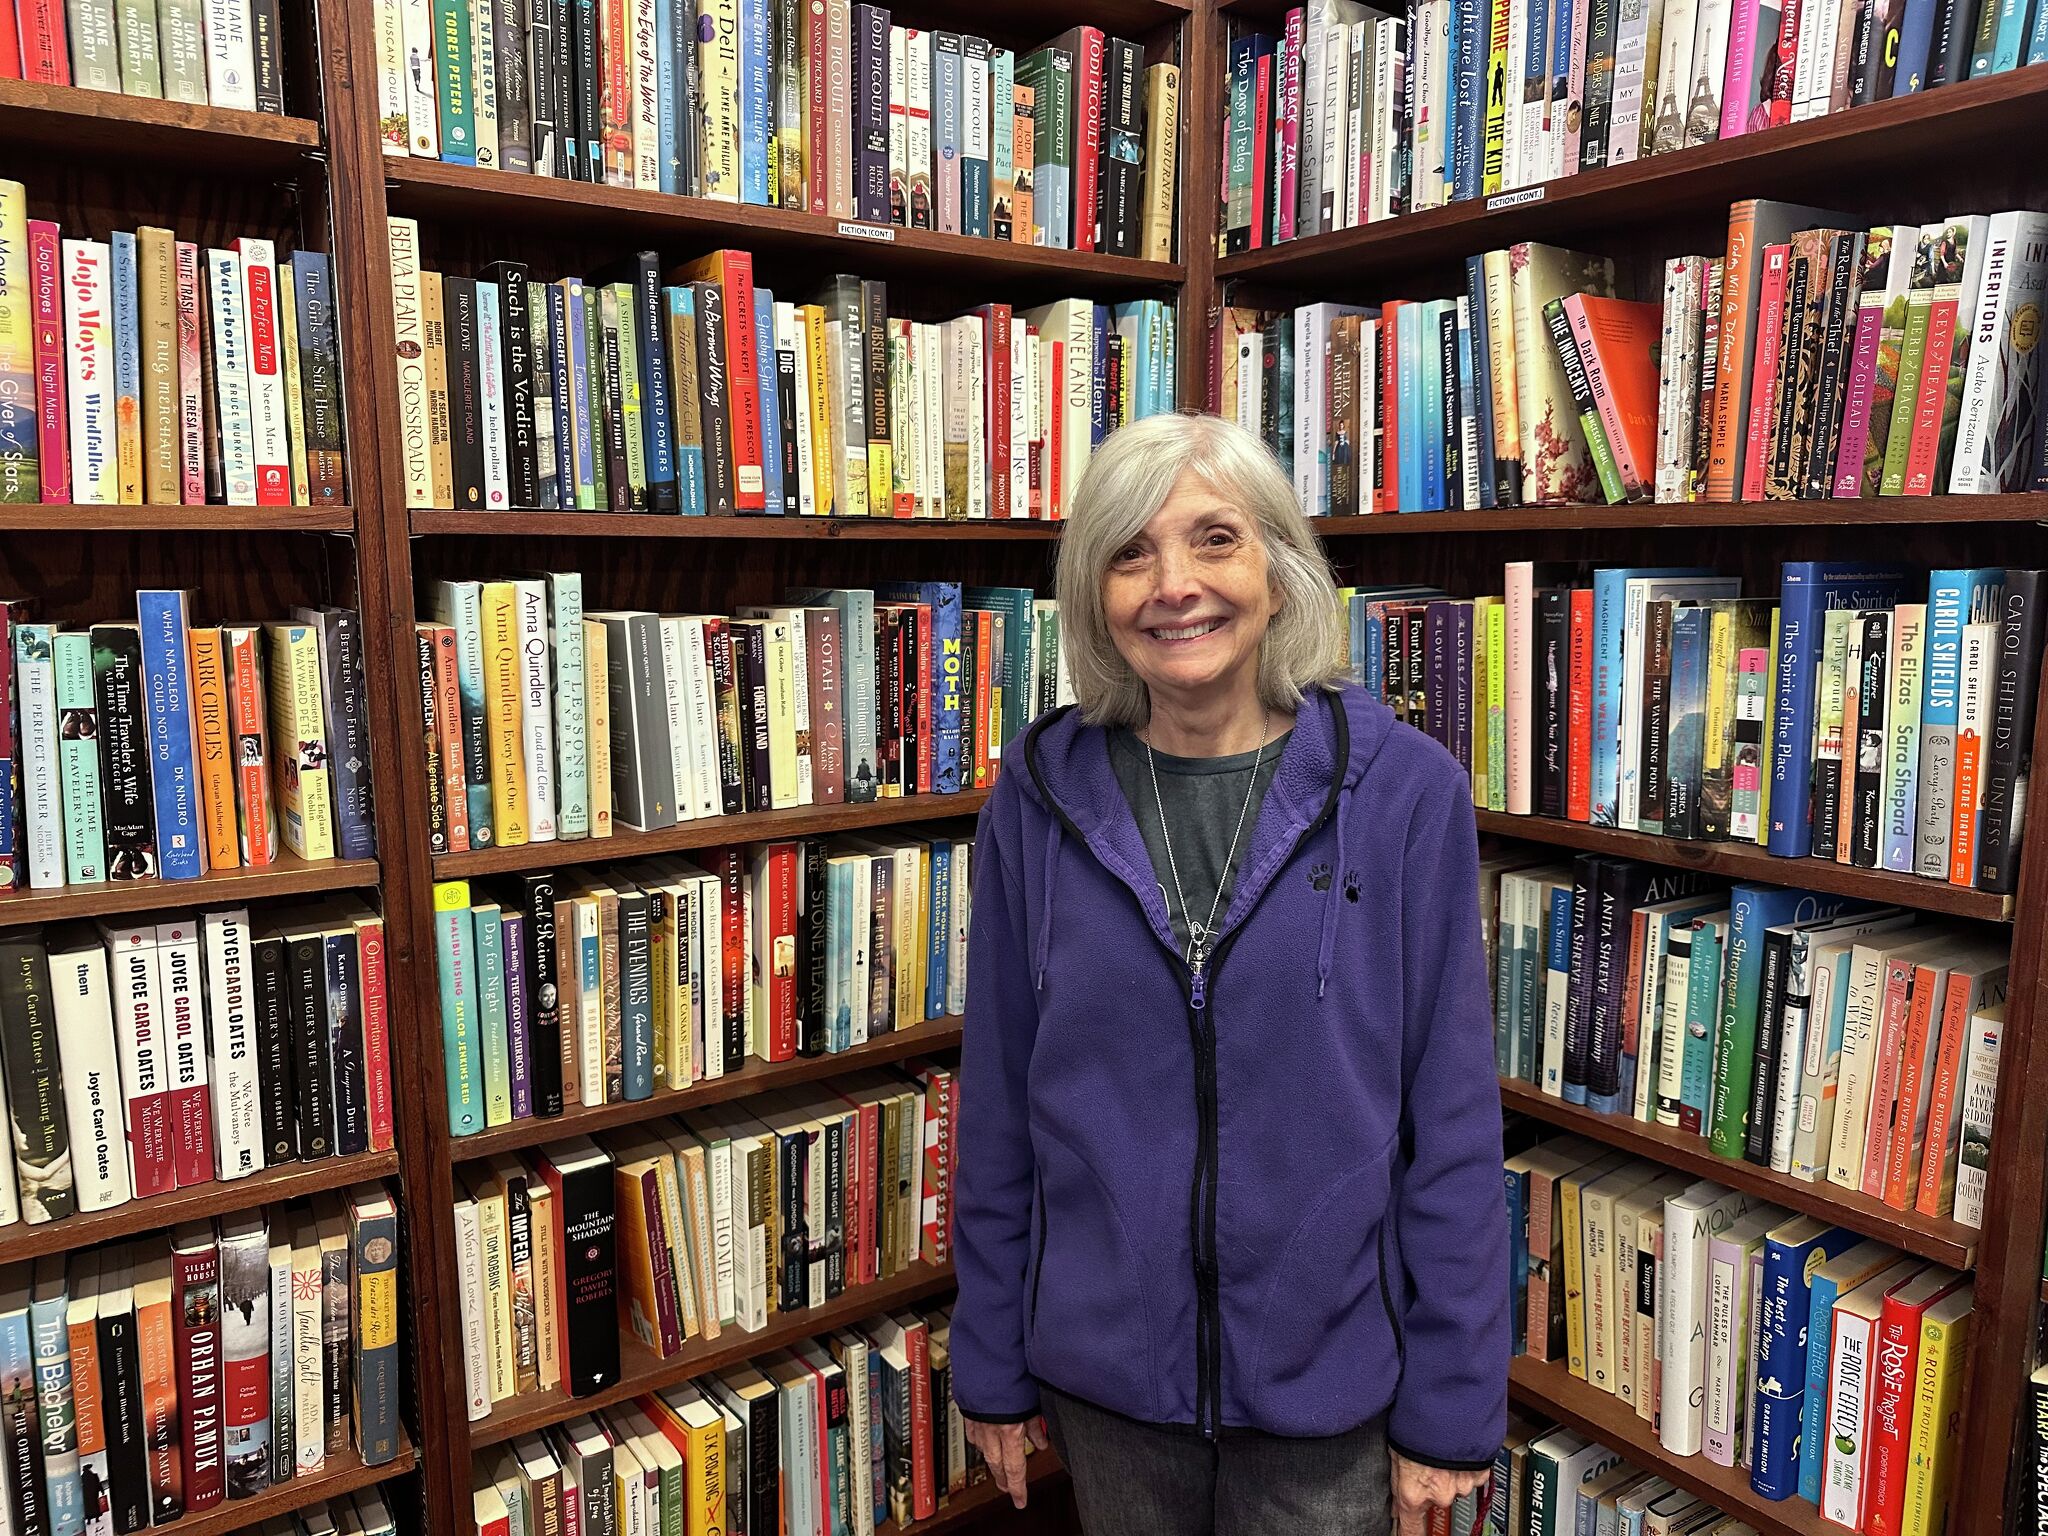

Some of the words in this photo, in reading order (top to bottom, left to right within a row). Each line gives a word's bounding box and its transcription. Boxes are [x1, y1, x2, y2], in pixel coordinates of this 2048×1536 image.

[125, 6, 141, 76] MORIARTY
[139, 22, 154, 62] LIANE
[445, 10, 460, 57] TORREY
[870, 12, 884, 54] JODI
[1288, 16, 1300, 51] LET'S
[1088, 34, 1105, 74] JODI
[1288, 53, 1300, 83] GET
[447, 59, 463, 117] PETERS
[869, 55, 884, 126] PICOULT
[1286, 86, 1299, 124] BACK
[1087, 75, 1103, 150] PICOULT
[1161, 93, 1175, 212] WOODSBURNER
[868, 165, 876, 196] RULES
[875, 165, 884, 199] HOUSE
[1488, 196, 1515, 210] FICTION
[1515, 189, 1544, 204] (CONT.)
[389, 224, 411, 281] BELVA
[840, 225, 868, 238] FICTION
[868, 229, 894, 240] (CONT.)
[38, 246, 52, 277] Jojo
[71, 249, 99, 301] Jojo
[179, 247, 192, 281] WHITE
[305, 270, 320, 293] The
[40, 279, 52, 314] Moyes
[180, 283, 194, 319] TRASH
[254, 271, 268, 293] The
[507, 270, 523, 319] Such
[1978, 239, 2007, 344] INHERITORS
[219, 260, 236, 371] Waterborne
[254, 296, 269, 345] Perfect
[306, 297, 322, 333] Girls
[394, 284, 419, 339] PLAIN
[647, 270, 659, 342] Bewilderment
[847, 304, 860, 346] FATAL
[1549, 313, 1567, 337] THE
[75, 307, 101, 382] Moyes
[510, 325, 521, 341] is
[1859, 314, 1875, 356] BALM
[258, 347, 269, 370] Man
[312, 347, 321, 363] the
[512, 345, 524, 374] the
[779, 352, 794, 375] DIG
[1069, 310, 1087, 409] VINELAND
[1556, 336, 1591, 401] INNOCENTS
[44, 362, 55, 399] Night
[312, 364, 325, 395] Stilt
[652, 358, 665, 416] RICHARD
[850, 356, 864, 426] INCIDENT
[46, 399, 56, 430] Music
[313, 400, 326, 440] House
[514, 376, 530, 449] Verdict
[1849, 374, 1866, 430] GILEAD
[85, 393, 101, 483] Windfallen
[402, 364, 427, 482] CROSSROADS
[655, 418, 668, 473] POWERS
[161, 609, 173, 644] WHAT
[495, 599, 510, 647] Anna
[524, 590, 541, 634] Anna
[568, 589, 582, 674] OBJECT
[1388, 615, 1400, 648] Four
[1933, 588, 1961, 641] CAROL
[2003, 594, 2024, 659] CAROL
[419, 637, 431, 669] ANNA
[1784, 621, 1800, 649] The
[1899, 622, 1919, 652] The
[114, 655, 128, 680] The
[196, 641, 215, 689] DARK
[524, 638, 546, 709] Quindlen
[821, 632, 835, 694] SOTAH
[942, 638, 961, 712] MOTH
[1388, 649, 1398, 686] Meals
[1780, 654, 1797, 694] Spirit
[1968, 639, 1980, 672] CAROL
[164, 649, 179, 713] NAPOLEON
[496, 650, 513, 723] Quindlen
[1652, 678, 1662, 700] THE
[1898, 654, 1918, 706] Elizas
[1929, 643, 1958, 709] SHIELDS
[115, 680, 129, 714] Time
[422, 670, 435, 727] QUINDLEN
[753, 685, 765, 725] FOREIGN
[1780, 697, 1795, 715] of
[1966, 675, 1978, 721] SHIELDS
[1995, 669, 2017, 751] SHIELDS
[118, 715, 133, 772] Traveler's
[200, 692, 223, 761] CIRCLES
[571, 681, 585, 780] LESSONS
[755, 725, 768, 750] LAND
[1649, 703, 1661, 764] VANISHING
[1778, 716, 1794, 738] the
[1896, 725, 1913, 760] Sara
[472, 716, 485, 781] BLESSINGS
[1776, 743, 1792, 781] Place
[123, 774, 134, 806] Wife
[174, 767, 184, 783] DK
[1648, 766, 1658, 801] POINT
[175, 786, 189, 826] NNURO
[1670, 776, 1678, 818] SHATTUCK
[1678, 782, 1687, 814] JESSICA
[1893, 764, 1912, 838] Shepard
[533, 883, 555, 917] Carl
[1573, 884, 1588, 929] ANITA
[1731, 902, 1750, 936] Gary
[450, 915, 460, 959] MALIBU
[627, 909, 647, 934] THE
[535, 917, 555, 982] Reiner
[1570, 934, 1585, 985] SHREVE
[129, 956, 148, 1000] JOYCE
[453, 960, 463, 997] RISING
[629, 939, 649, 1007] EVENINGS
[1725, 937, 1747, 1010] Shteyngart
[1863, 961, 1879, 990] TEN
[133, 1003, 152, 1047] CAROL
[456, 1000, 466, 1039] TAYLOR
[1723, 1014, 1736, 1037] Our
[1858, 994, 1873, 1042] GIRLS
[137, 1049, 155, 1091] OATES
[458, 1040, 469, 1079] JENKINS
[1718, 1039, 1734, 1083] Country
[88, 1071, 101, 1108] Joyce
[460, 1081, 470, 1105] REID
[1716, 1082, 1730, 1122] Friends
[1939, 1068, 1950, 1101] ANNE
[92, 1109, 105, 1144] Carol
[1932, 1102, 1946, 1141] RIVERS
[96, 1145, 109, 1181] Oates
[1924, 1142, 1939, 1190] SIDDONS
[566, 1213, 615, 1234] MOUNTAIN
[572, 1223, 612, 1243] SHADOW
[584, 1210, 600, 1221] THE
[1692, 1195, 1749, 1240] MONA
[184, 1260, 217, 1274] SILENT
[511, 1213, 532, 1288] IMPERIAL
[716, 1215, 733, 1283] HOME
[187, 1269, 216, 1282] HOUSE
[1776, 1275, 1790, 1294] The
[1764, 1296, 1773, 1328] Adam
[1774, 1323, 1786, 1337] of
[1775, 1297, 1788, 1323] Best
[37, 1315, 61, 1359] The
[1759, 1329, 1773, 1361] Sharp
[1843, 1335, 1862, 1354] THE
[190, 1330, 215, 1401] ORHAN
[40, 1362, 67, 1453] Bachelor
[1713, 1399, 1721, 1425] SIMSES
[1763, 1403, 1771, 1437] GRAEME
[1836, 1392, 1859, 1434] EFFECT
[193, 1403, 217, 1474] PAMUK
[1761, 1438, 1769, 1474] SIMSION
[704, 1453, 720, 1502] ROWLING
